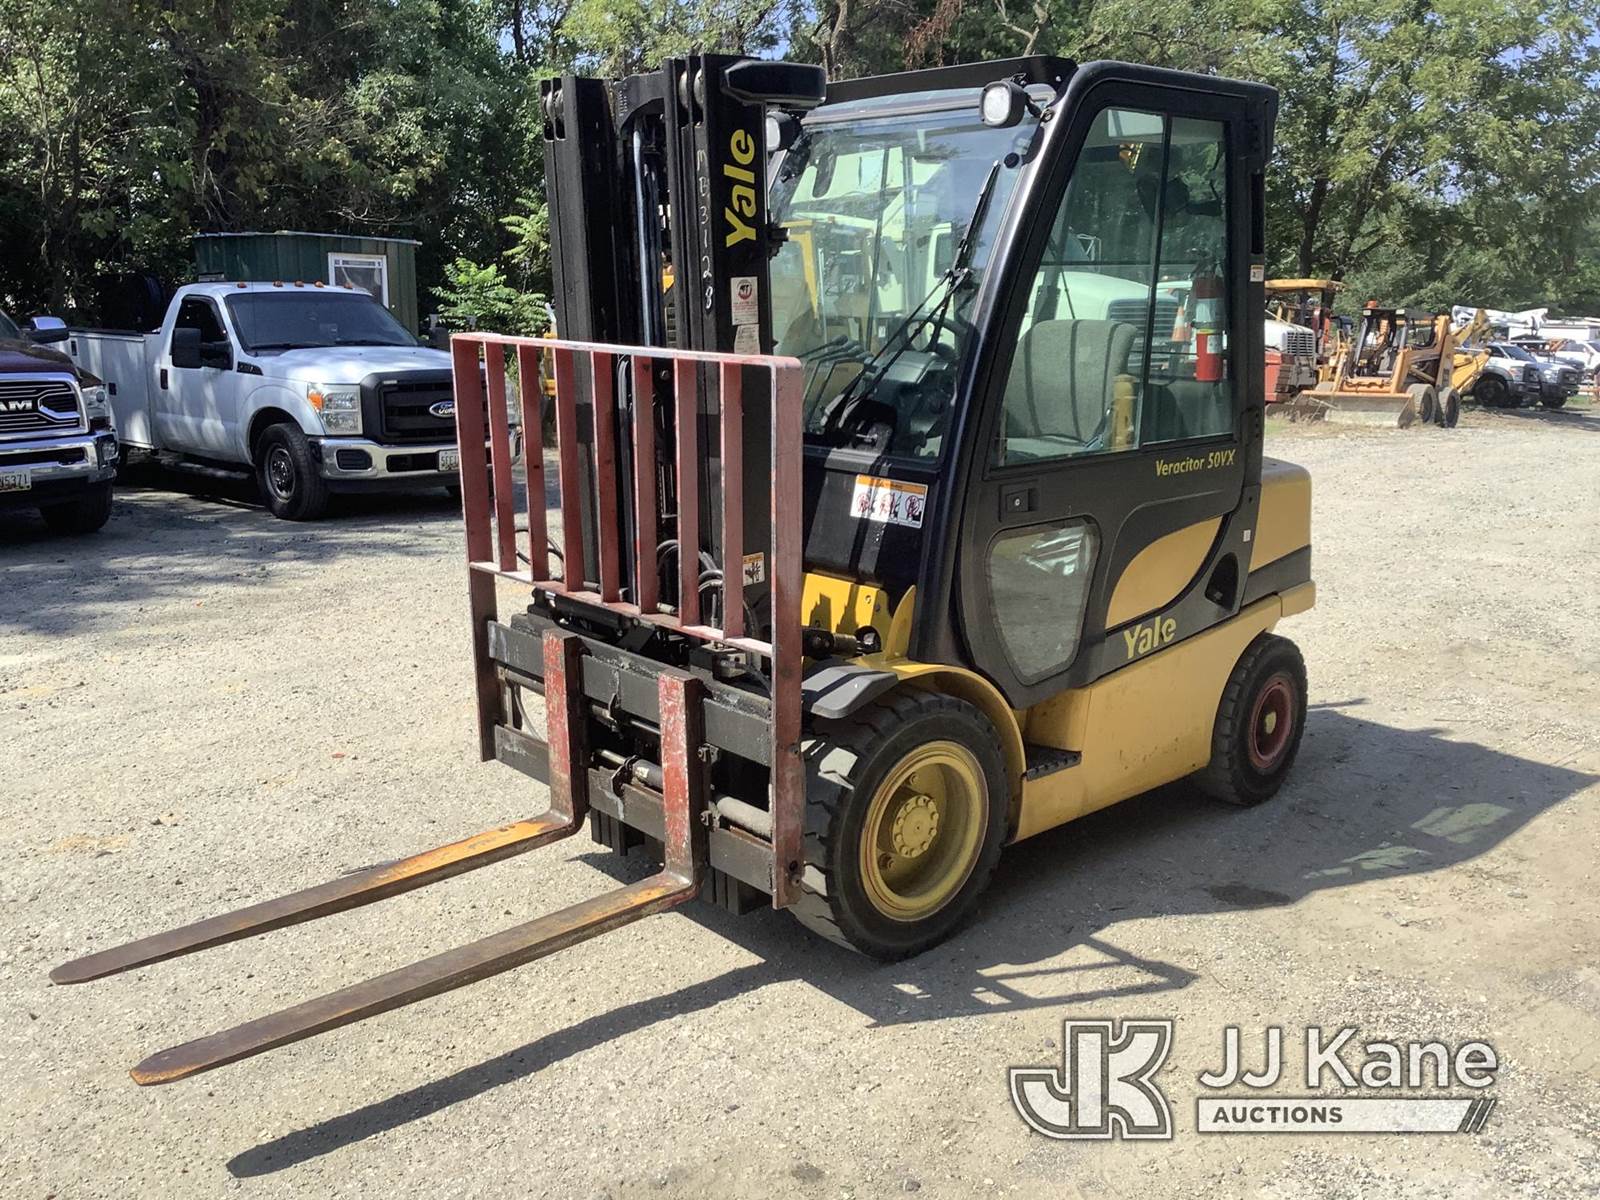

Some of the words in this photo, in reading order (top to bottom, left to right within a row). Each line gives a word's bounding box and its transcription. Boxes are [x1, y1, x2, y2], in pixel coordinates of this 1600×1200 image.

[723, 128, 757, 248] Yale
[1155, 456, 1206, 477] Veracitor
[1207, 448, 1236, 469] 50VX
[1123, 615, 1177, 660] Yale
